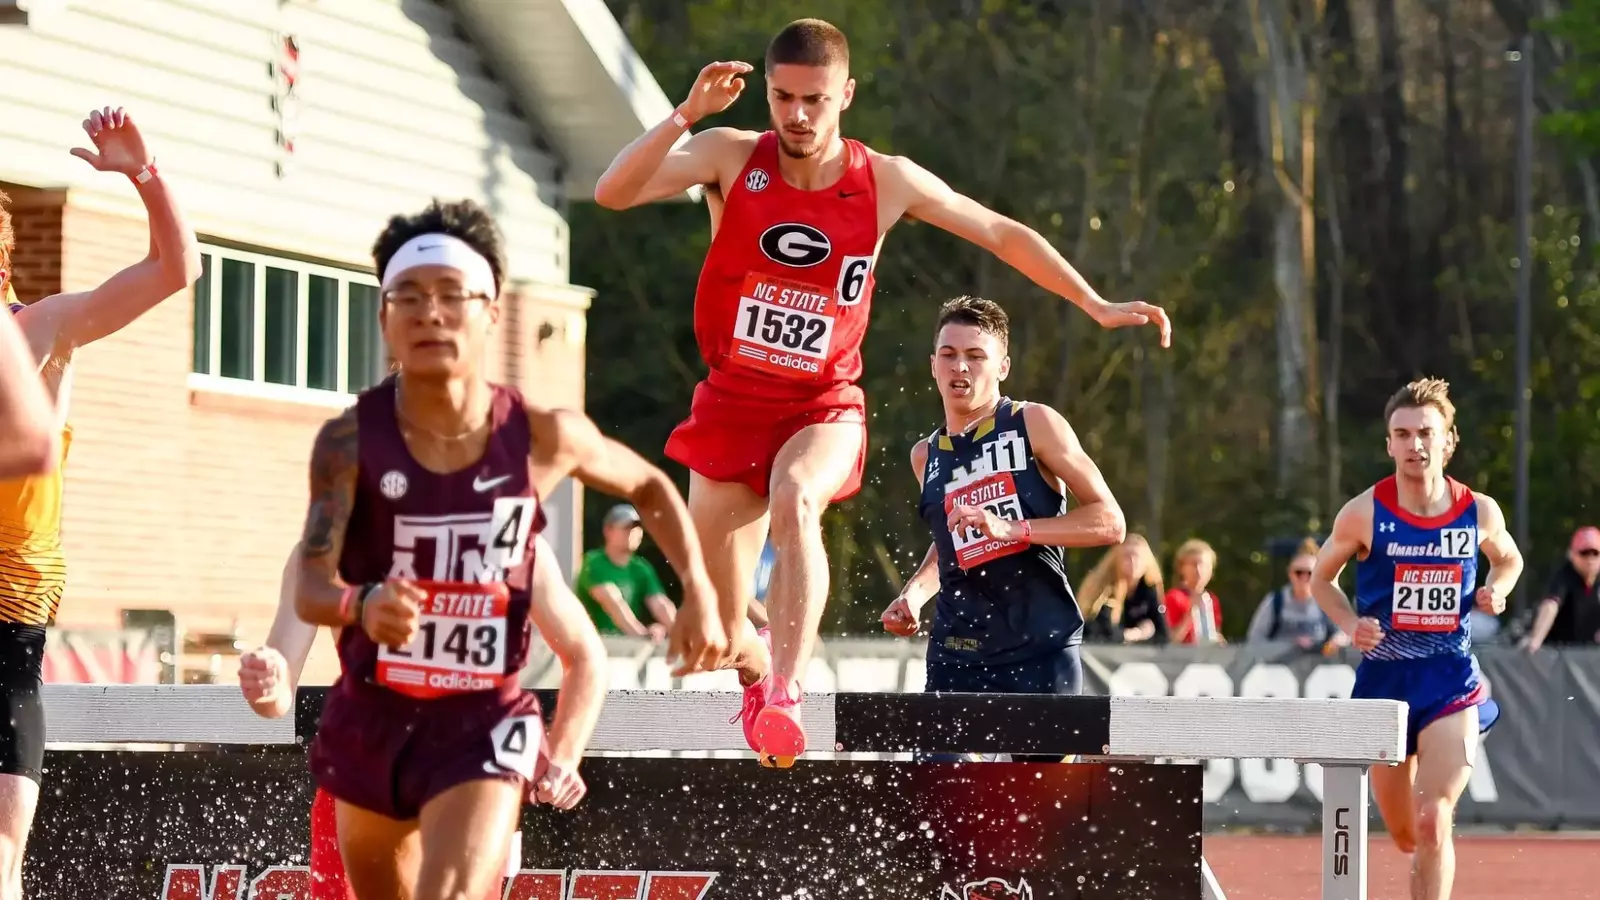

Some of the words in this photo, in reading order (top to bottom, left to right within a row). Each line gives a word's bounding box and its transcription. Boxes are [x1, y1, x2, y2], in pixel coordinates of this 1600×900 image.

[745, 168, 769, 191] SEC
[759, 223, 831, 267] G
[842, 260, 867, 302] 6
[753, 282, 778, 302] NC
[778, 288, 829, 313] STATE
[746, 304, 827, 354] 1532
[769, 352, 819, 373] adidas
[986, 440, 1019, 472] 11
[381, 471, 408, 499] SEC
[970, 481, 1006, 505] STATE
[493, 505, 523, 559] 4
[1443, 531, 1470, 556] 12
[1402, 569, 1418, 583] NC
[1421, 569, 1454, 583] STATE
[431, 593, 494, 618] STATE
[1397, 586, 1456, 611] 2193
[1420, 614, 1456, 625] adidas
[429, 673, 495, 690] adidas
[1334, 807, 1349, 876] UCS
